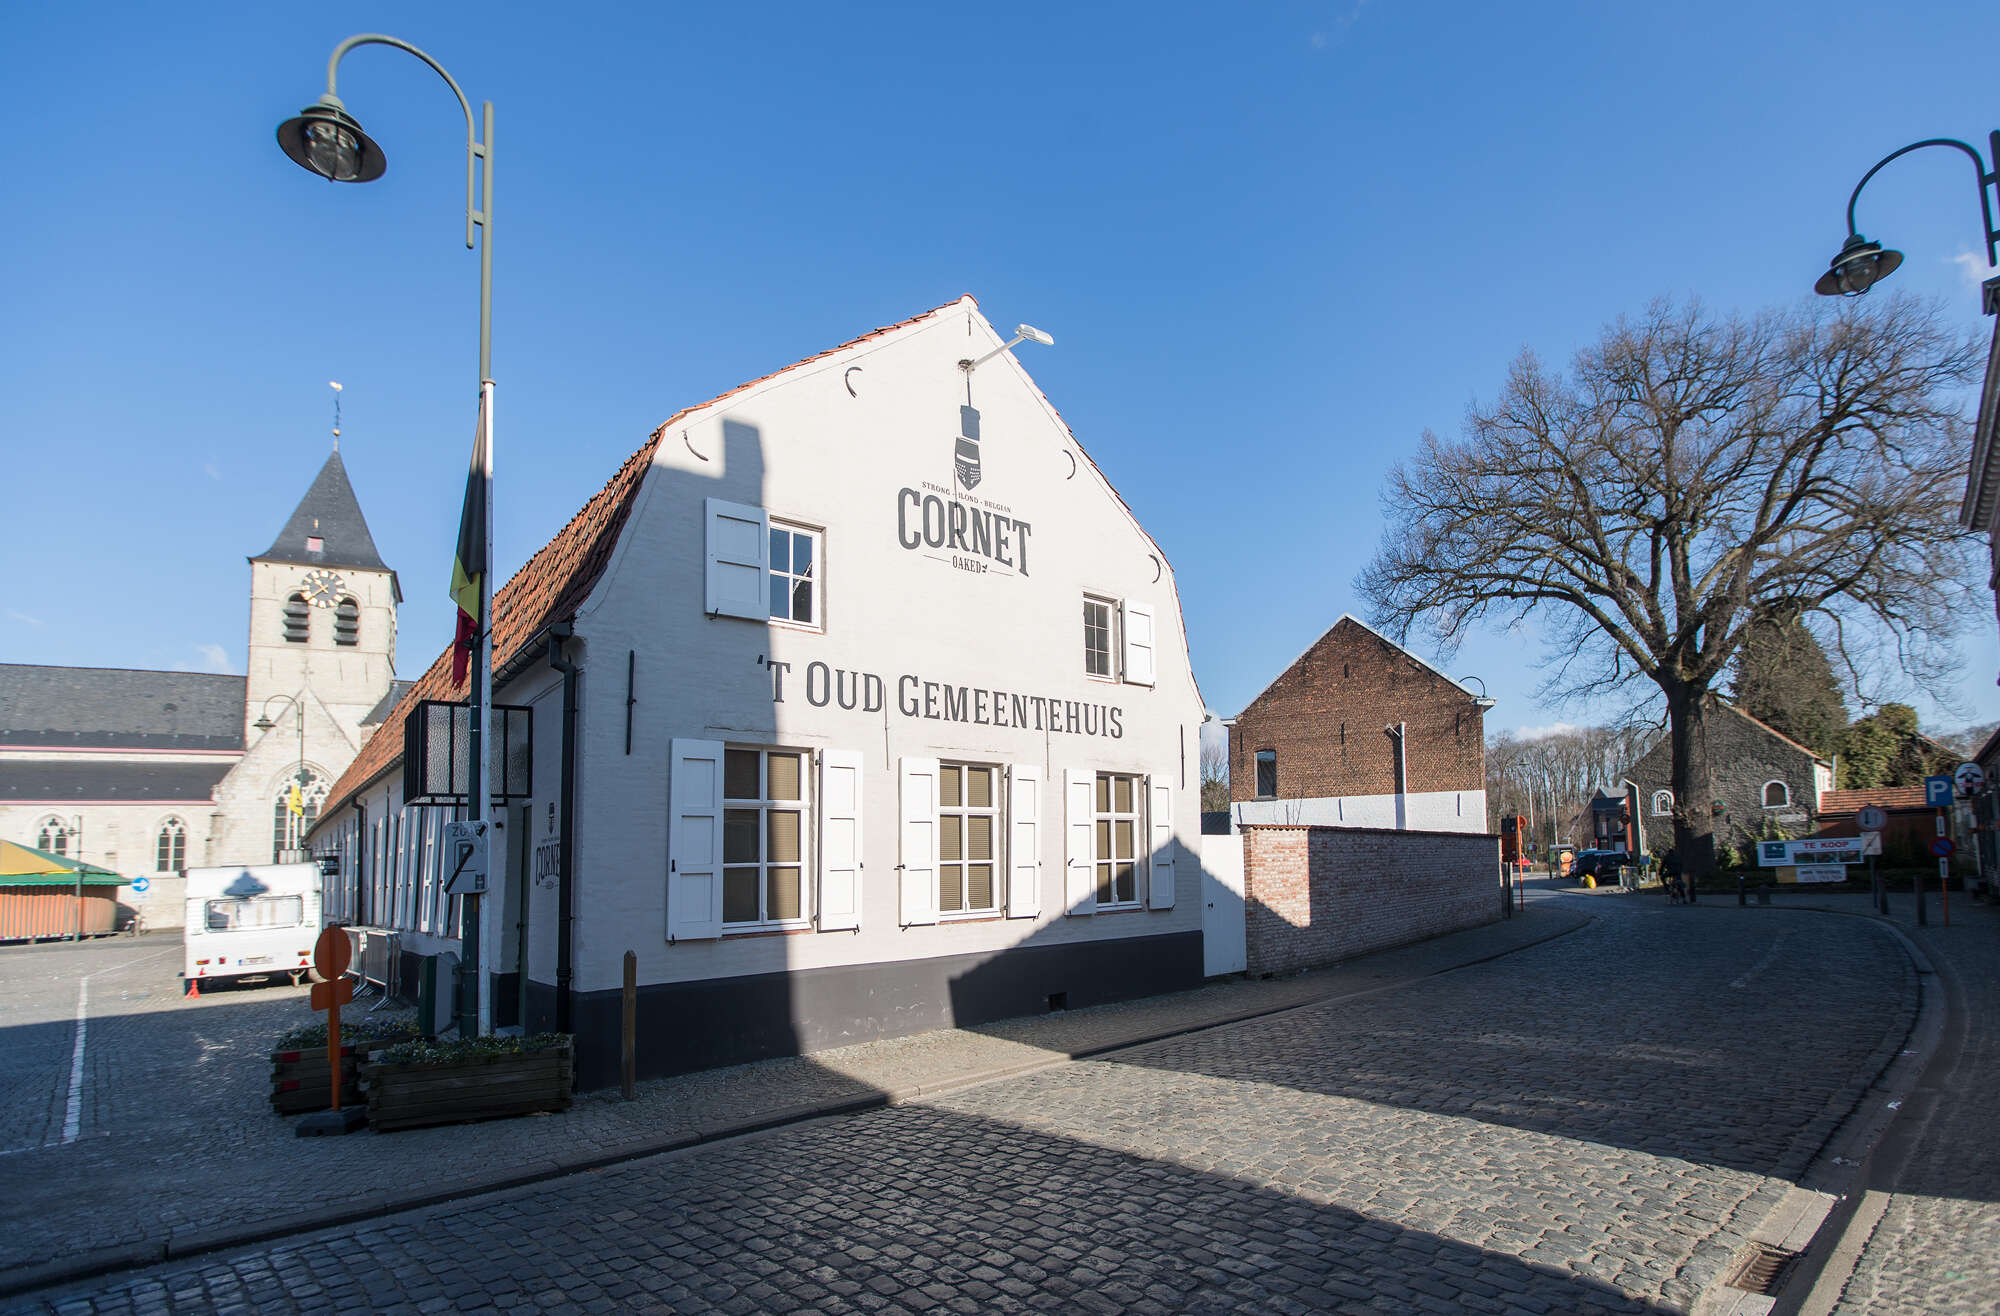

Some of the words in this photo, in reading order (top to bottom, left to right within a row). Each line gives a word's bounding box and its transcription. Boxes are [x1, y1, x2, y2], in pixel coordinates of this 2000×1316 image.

[922, 481, 951, 496] STRONG
[984, 500, 1012, 513] BELGIAN
[897, 487, 1032, 577] CORNET
[952, 555, 982, 574] OAKED
[806, 661, 883, 713] OUD
[898, 674, 1123, 739] GEMEENTEHUIS
[1928, 780, 1948, 802] P
[536, 842, 560, 886] CORNE
